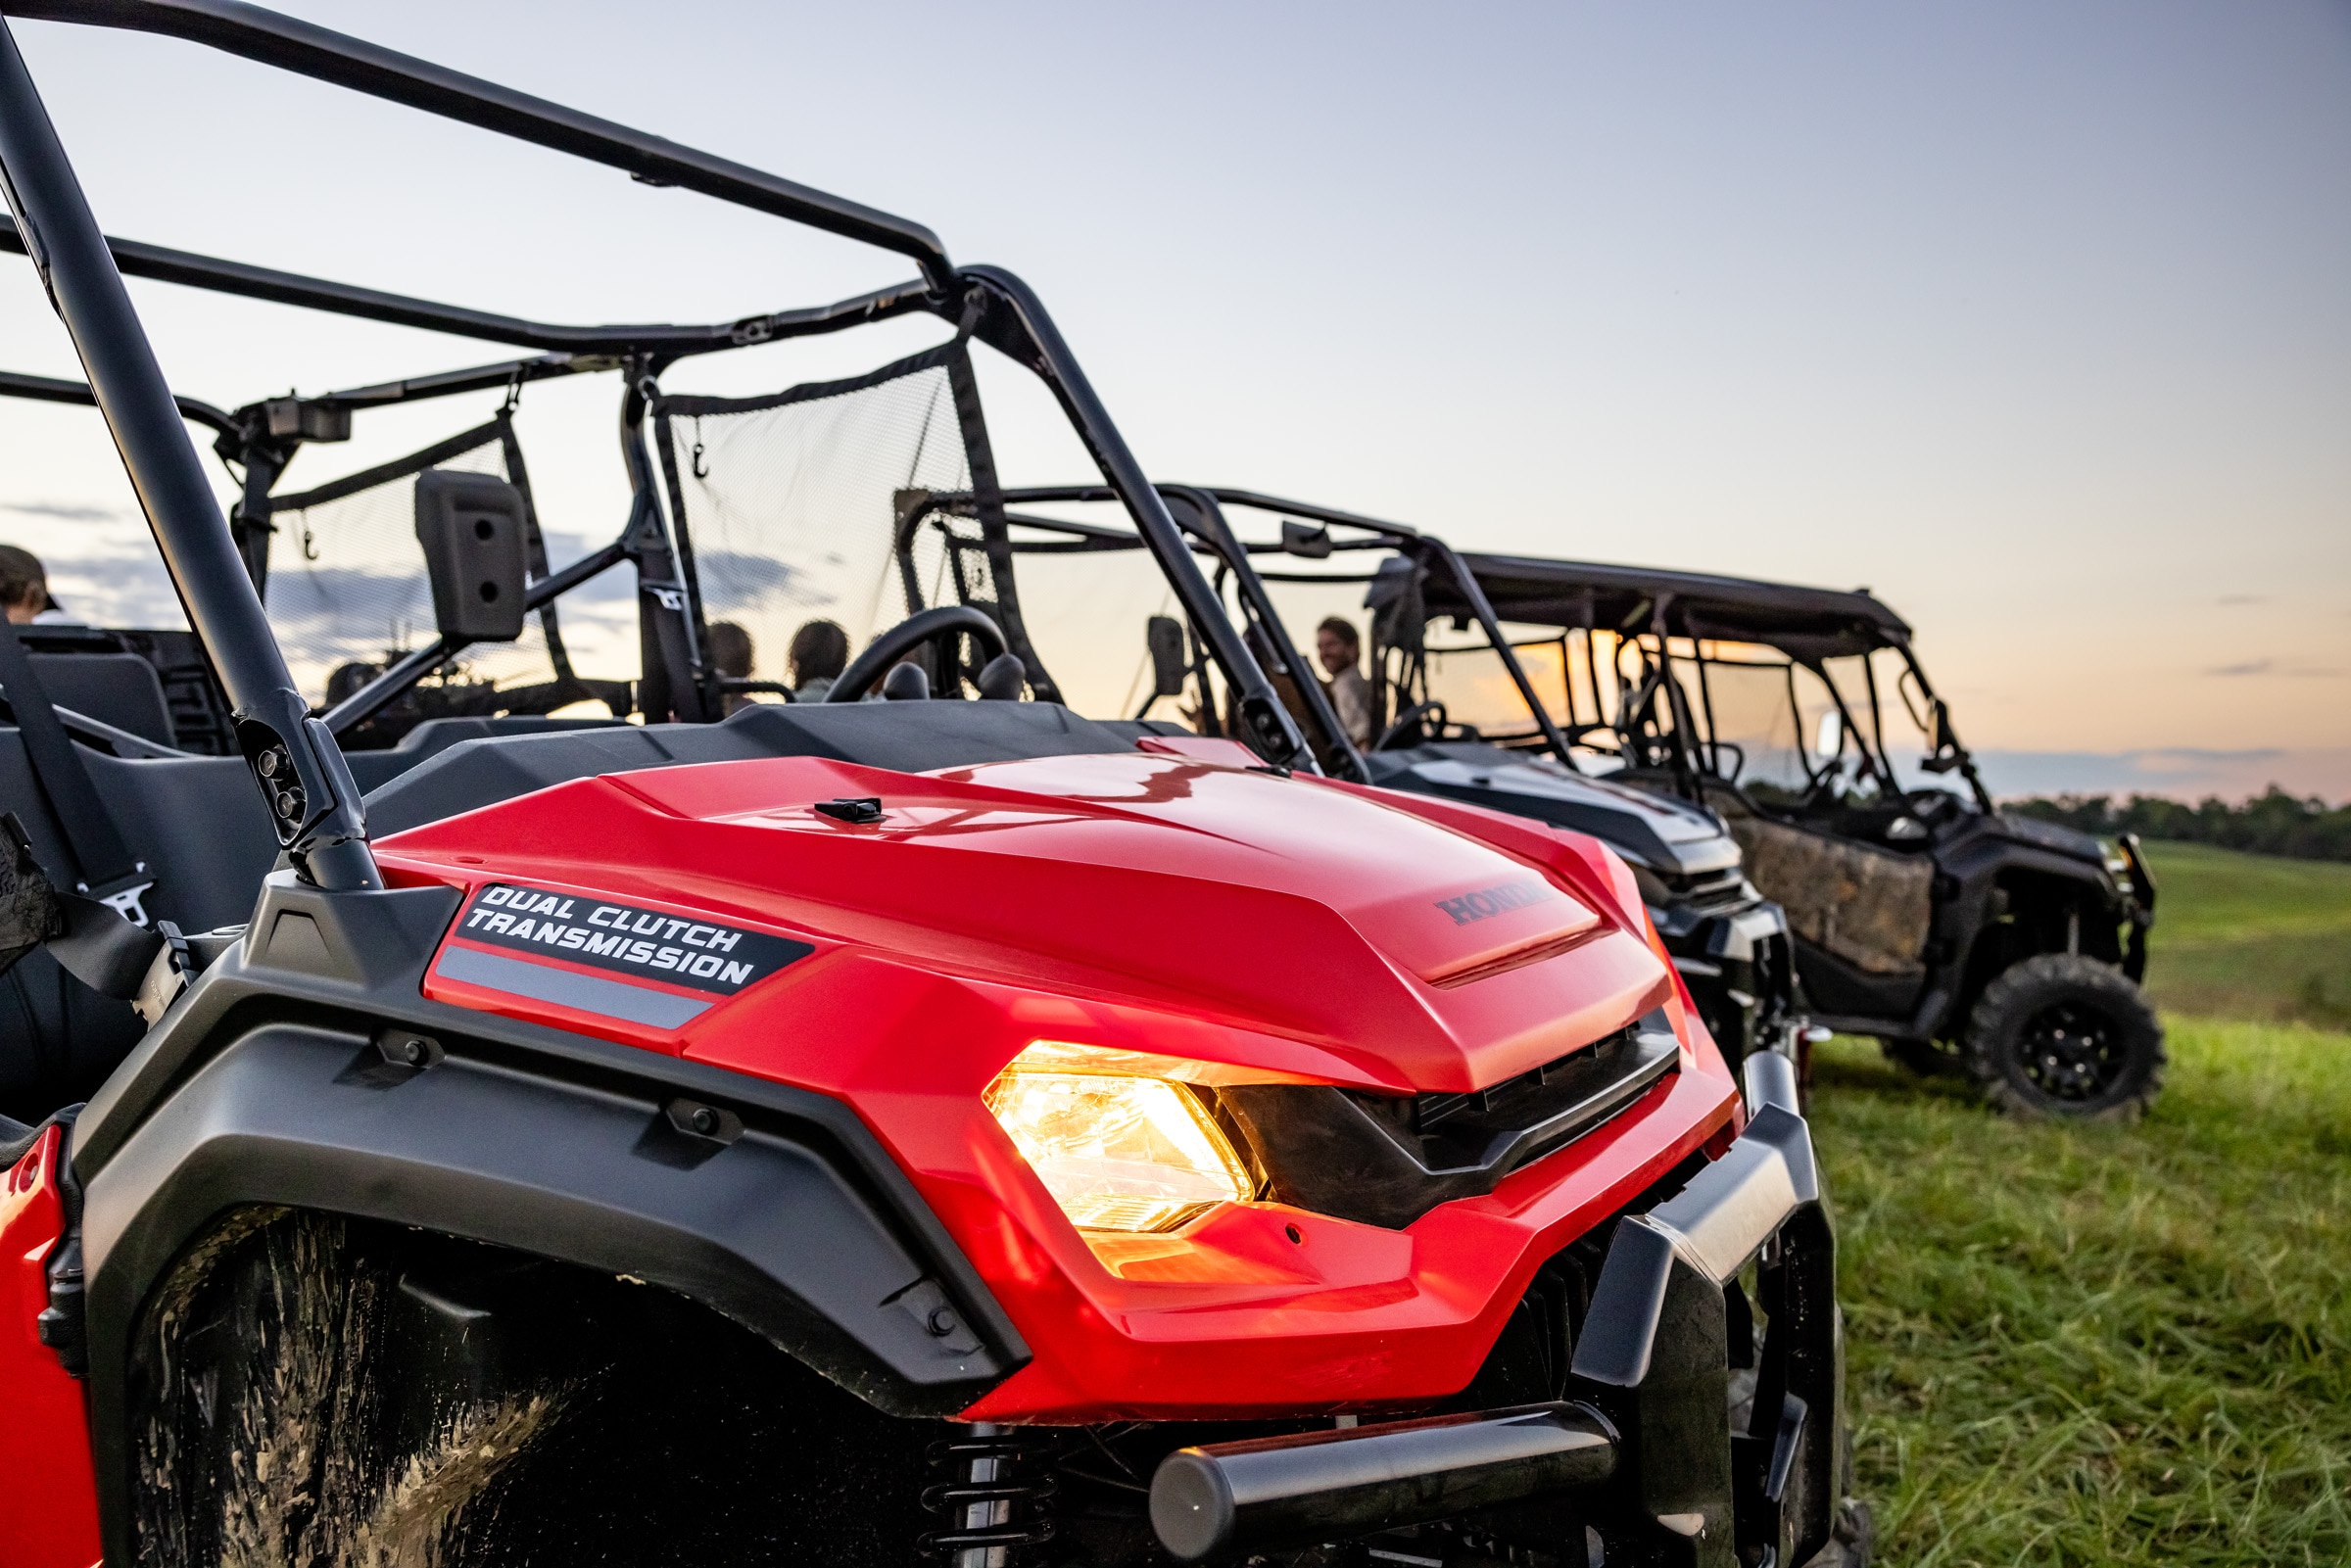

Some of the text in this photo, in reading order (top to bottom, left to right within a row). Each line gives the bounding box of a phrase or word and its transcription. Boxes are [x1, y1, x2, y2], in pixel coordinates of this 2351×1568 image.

[466, 907, 754, 985] TRANSMISSION
[481, 886, 743, 953] DUAL CLUTCH
